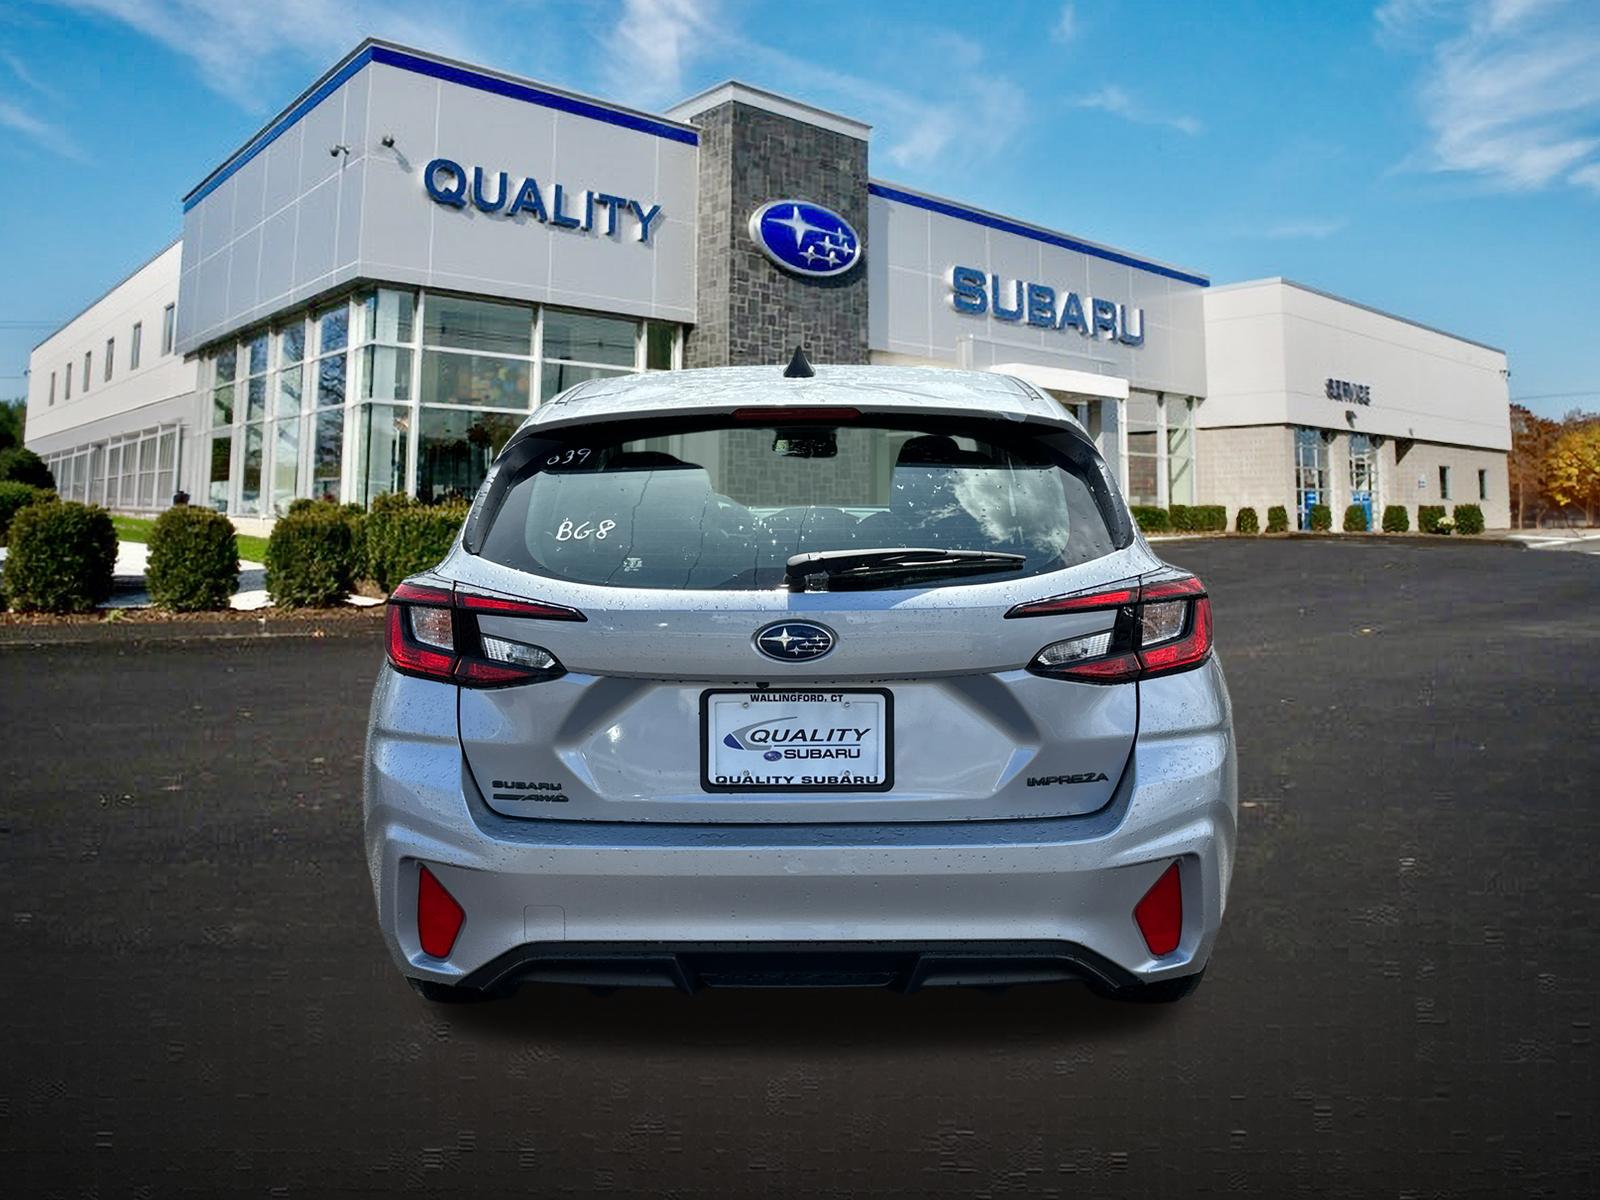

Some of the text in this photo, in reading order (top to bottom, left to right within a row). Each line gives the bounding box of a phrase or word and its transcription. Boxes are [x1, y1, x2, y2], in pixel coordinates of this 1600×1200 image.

[424, 158, 661, 242] QUALITY
[952, 265, 1145, 346] SUBARU
[831, 694, 844, 703] CT
[750, 728, 872, 743] QUALITY
[784, 749, 861, 759] SUBARU
[492, 780, 562, 790] SUBARU
[715, 776, 878, 784] QUALITY SUBARU
[1026, 772, 1109, 787] IMPREZA
